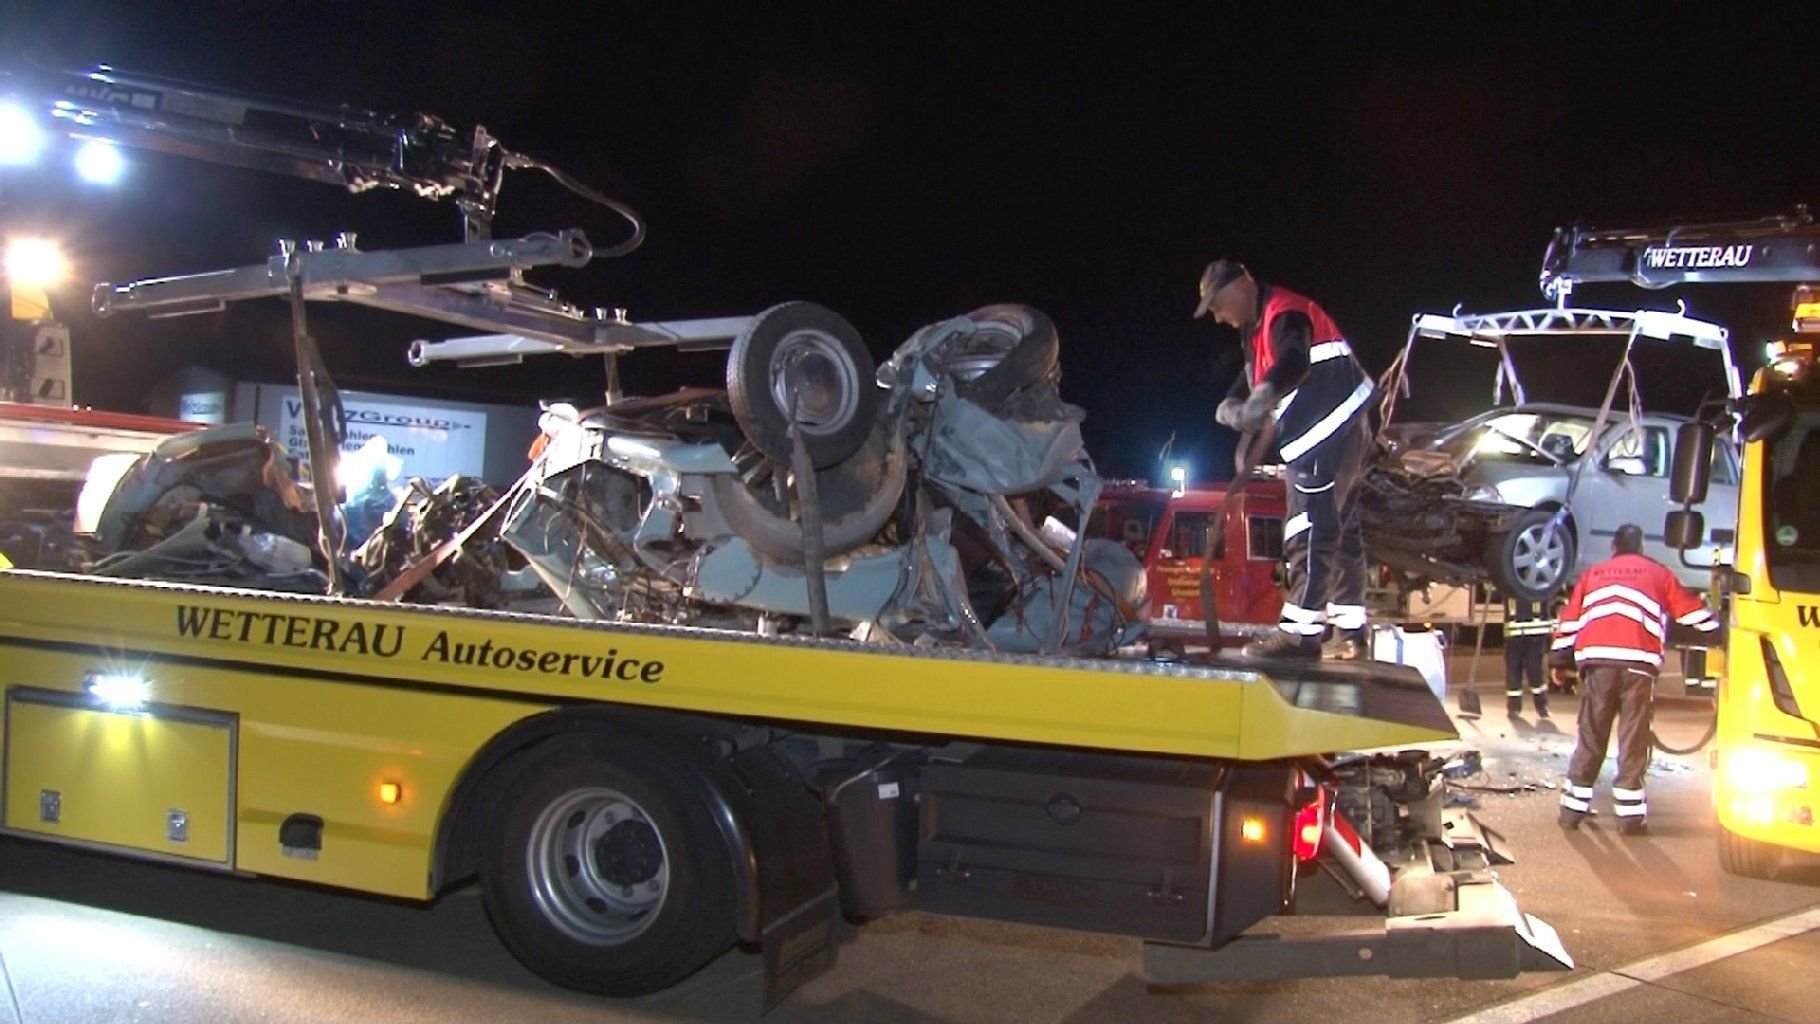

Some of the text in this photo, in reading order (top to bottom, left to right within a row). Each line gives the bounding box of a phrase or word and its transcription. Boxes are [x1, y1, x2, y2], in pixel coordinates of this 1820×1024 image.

[1648, 245, 1753, 268] WETTERAU
[176, 604, 666, 683] WETTERAU Autoservice
